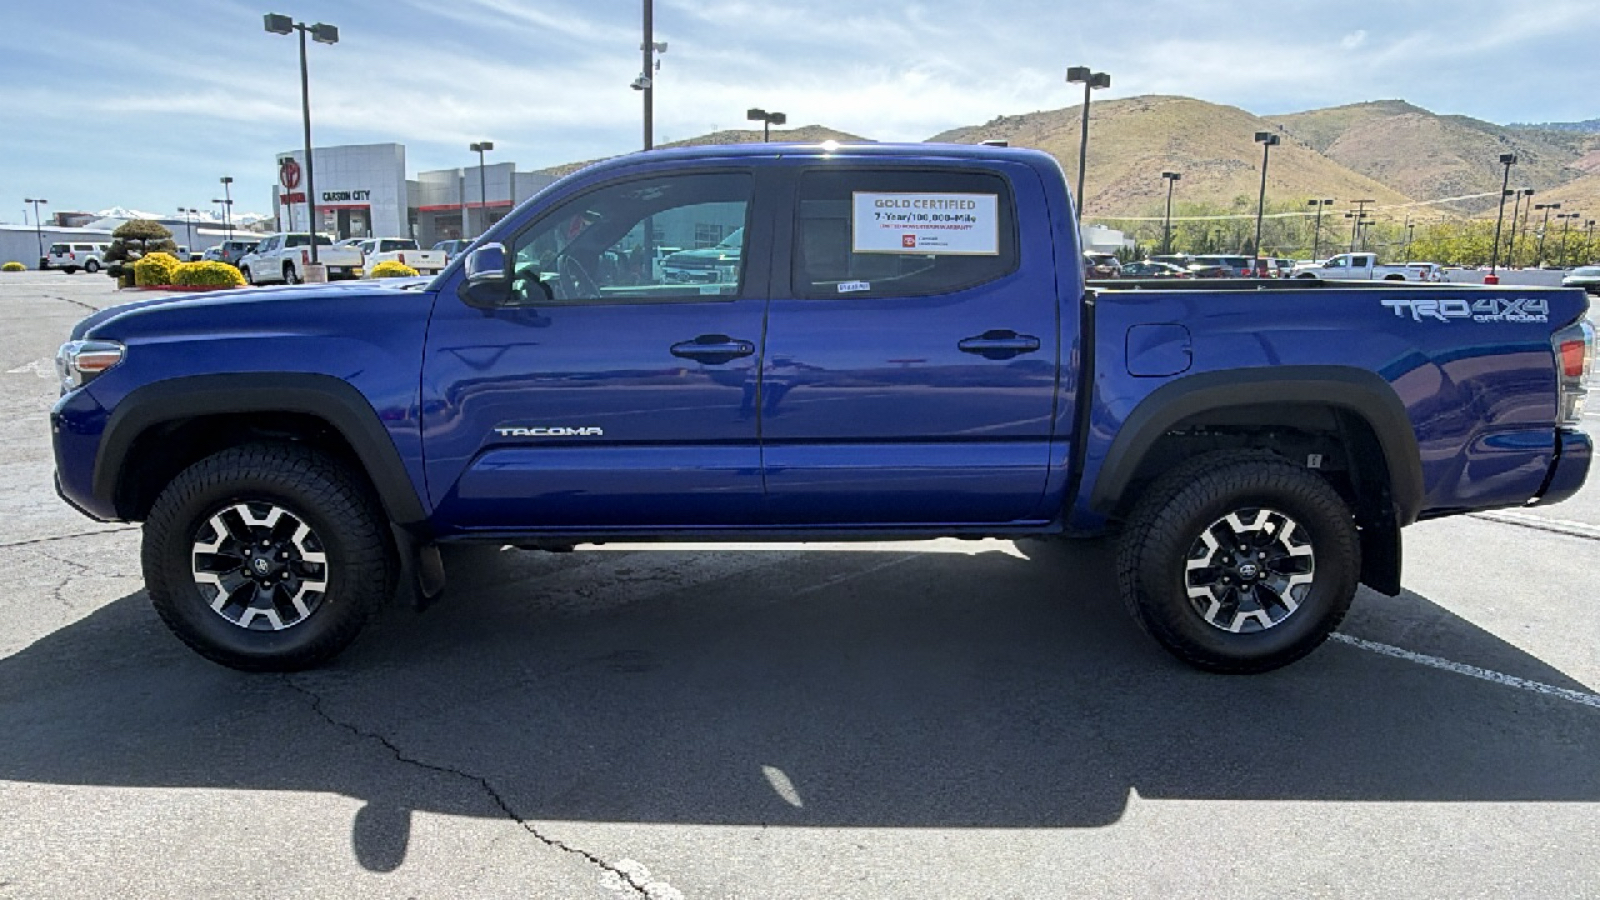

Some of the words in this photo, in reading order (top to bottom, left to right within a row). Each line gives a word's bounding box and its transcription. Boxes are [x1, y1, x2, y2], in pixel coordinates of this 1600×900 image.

[322, 192, 351, 202] CARSON
[352, 190, 371, 201] CITY
[874, 199, 911, 209] GOLD
[913, 199, 976, 210] CERTIFIED
[874, 211, 977, 223] 7-Year/100,000-Mile
[1381, 299, 1472, 323] TRD
[1473, 315, 1505, 323] OFF
[1506, 315, 1549, 323] ROAD
[494, 426, 604, 436] TACOMA
